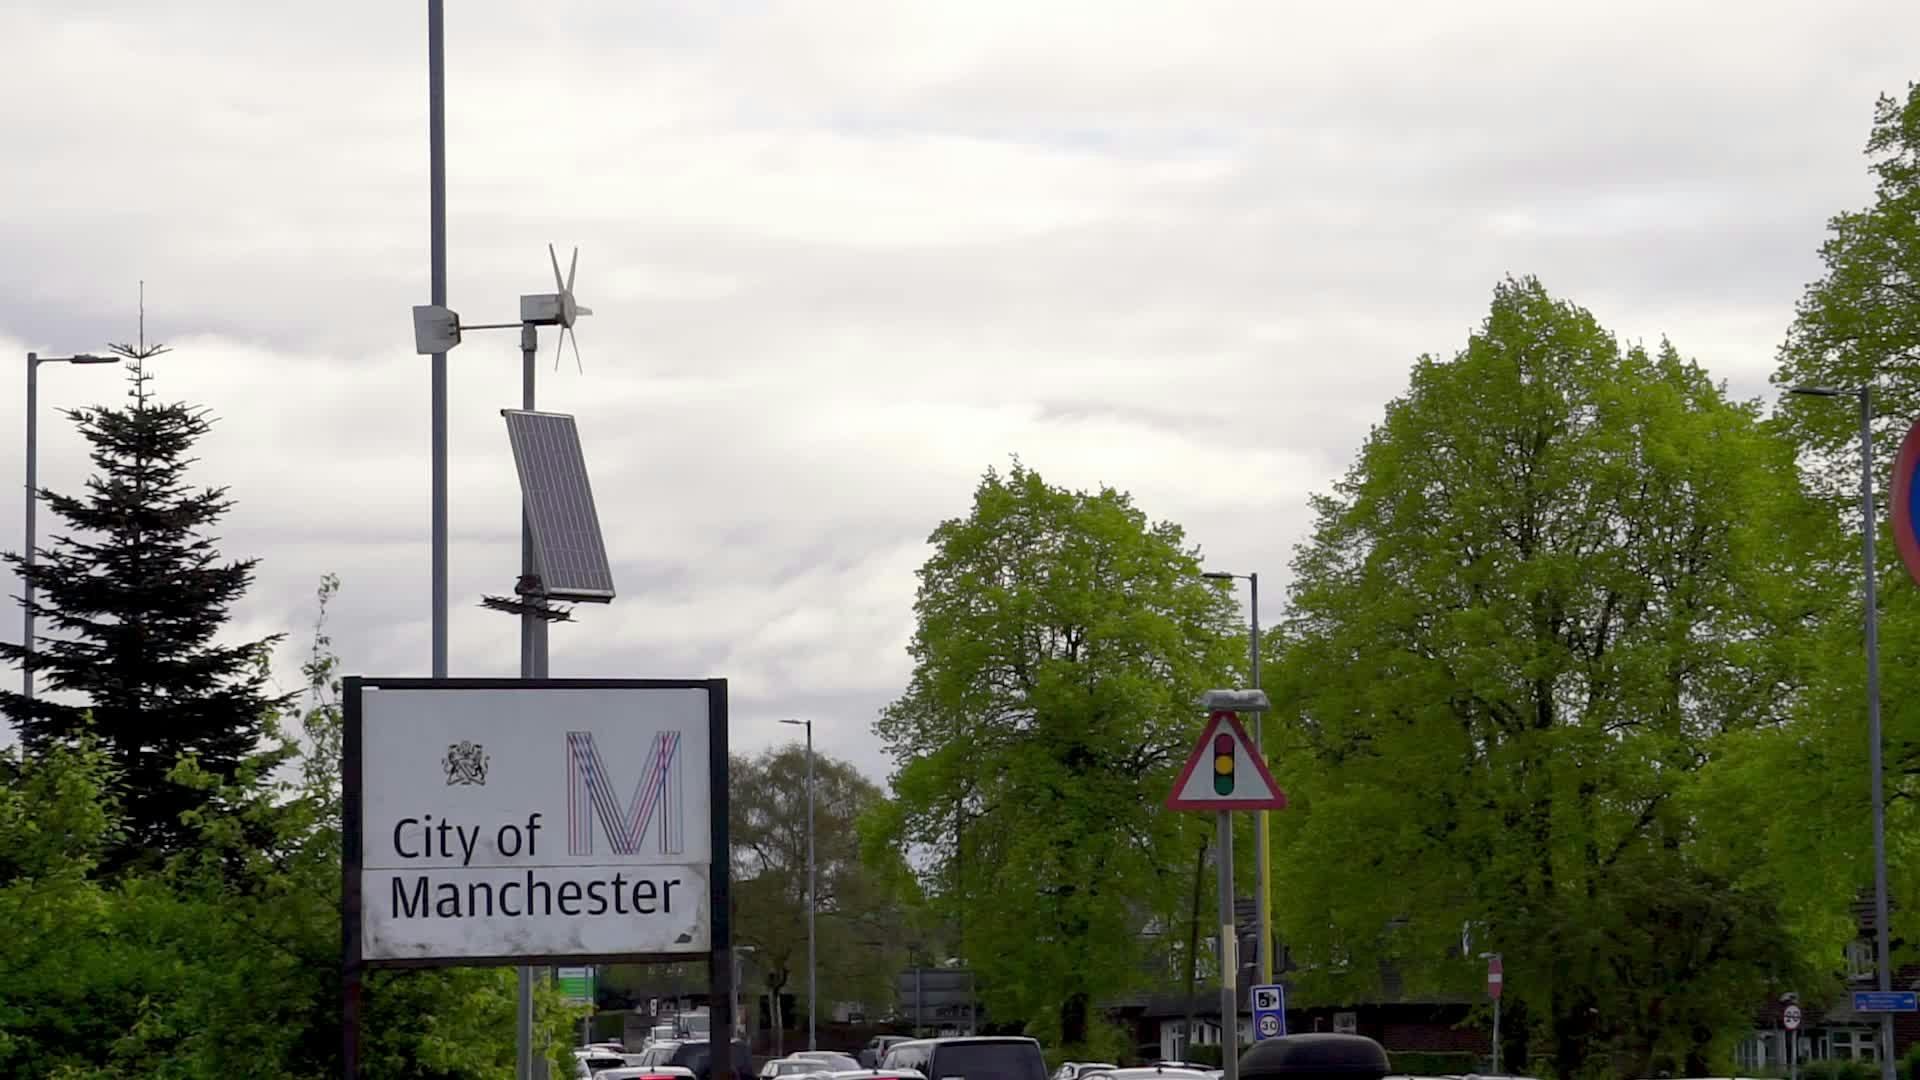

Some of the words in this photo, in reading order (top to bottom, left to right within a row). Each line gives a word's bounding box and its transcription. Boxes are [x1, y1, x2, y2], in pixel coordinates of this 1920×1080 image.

[566, 730, 684, 856] M
[393, 814, 480, 866] City
[497, 813, 543, 858] of
[391, 870, 681, 919] Manchester
[1262, 1020, 1277, 1031] 30
